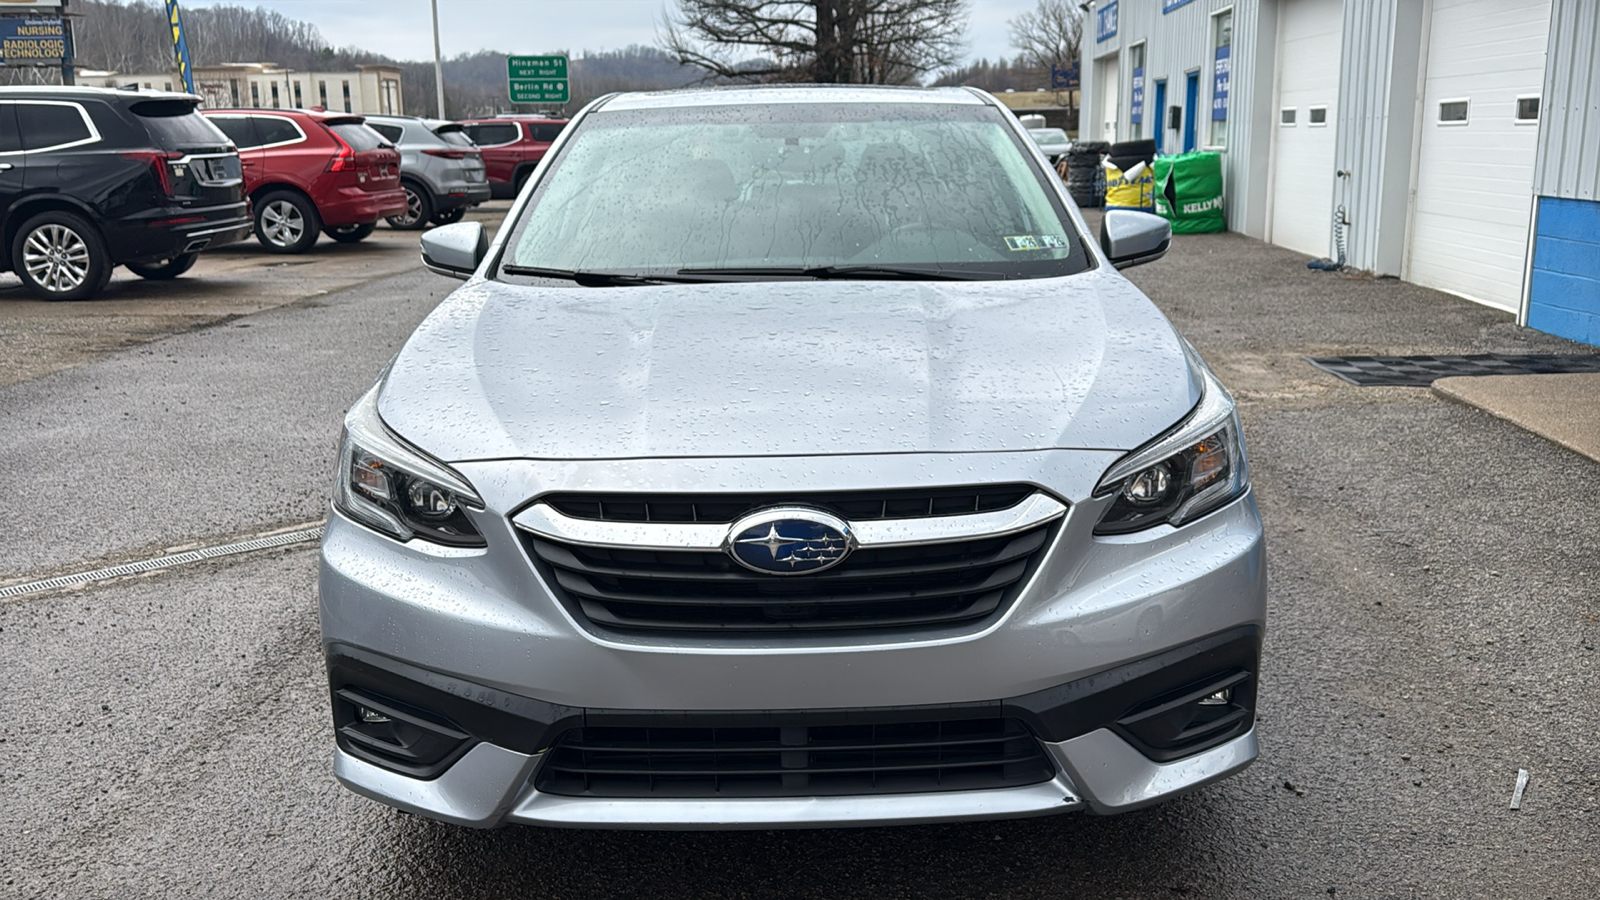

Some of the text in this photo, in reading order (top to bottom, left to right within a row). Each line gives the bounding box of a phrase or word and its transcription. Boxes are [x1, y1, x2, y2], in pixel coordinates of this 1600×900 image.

[17, 26, 63, 36] NURSING
[3, 39, 65, 49] RADIOLOGIC
[553, 59, 562, 67] St
[514, 83, 553, 91] Berlin Rd
[1183, 200, 1213, 214] KELLY
